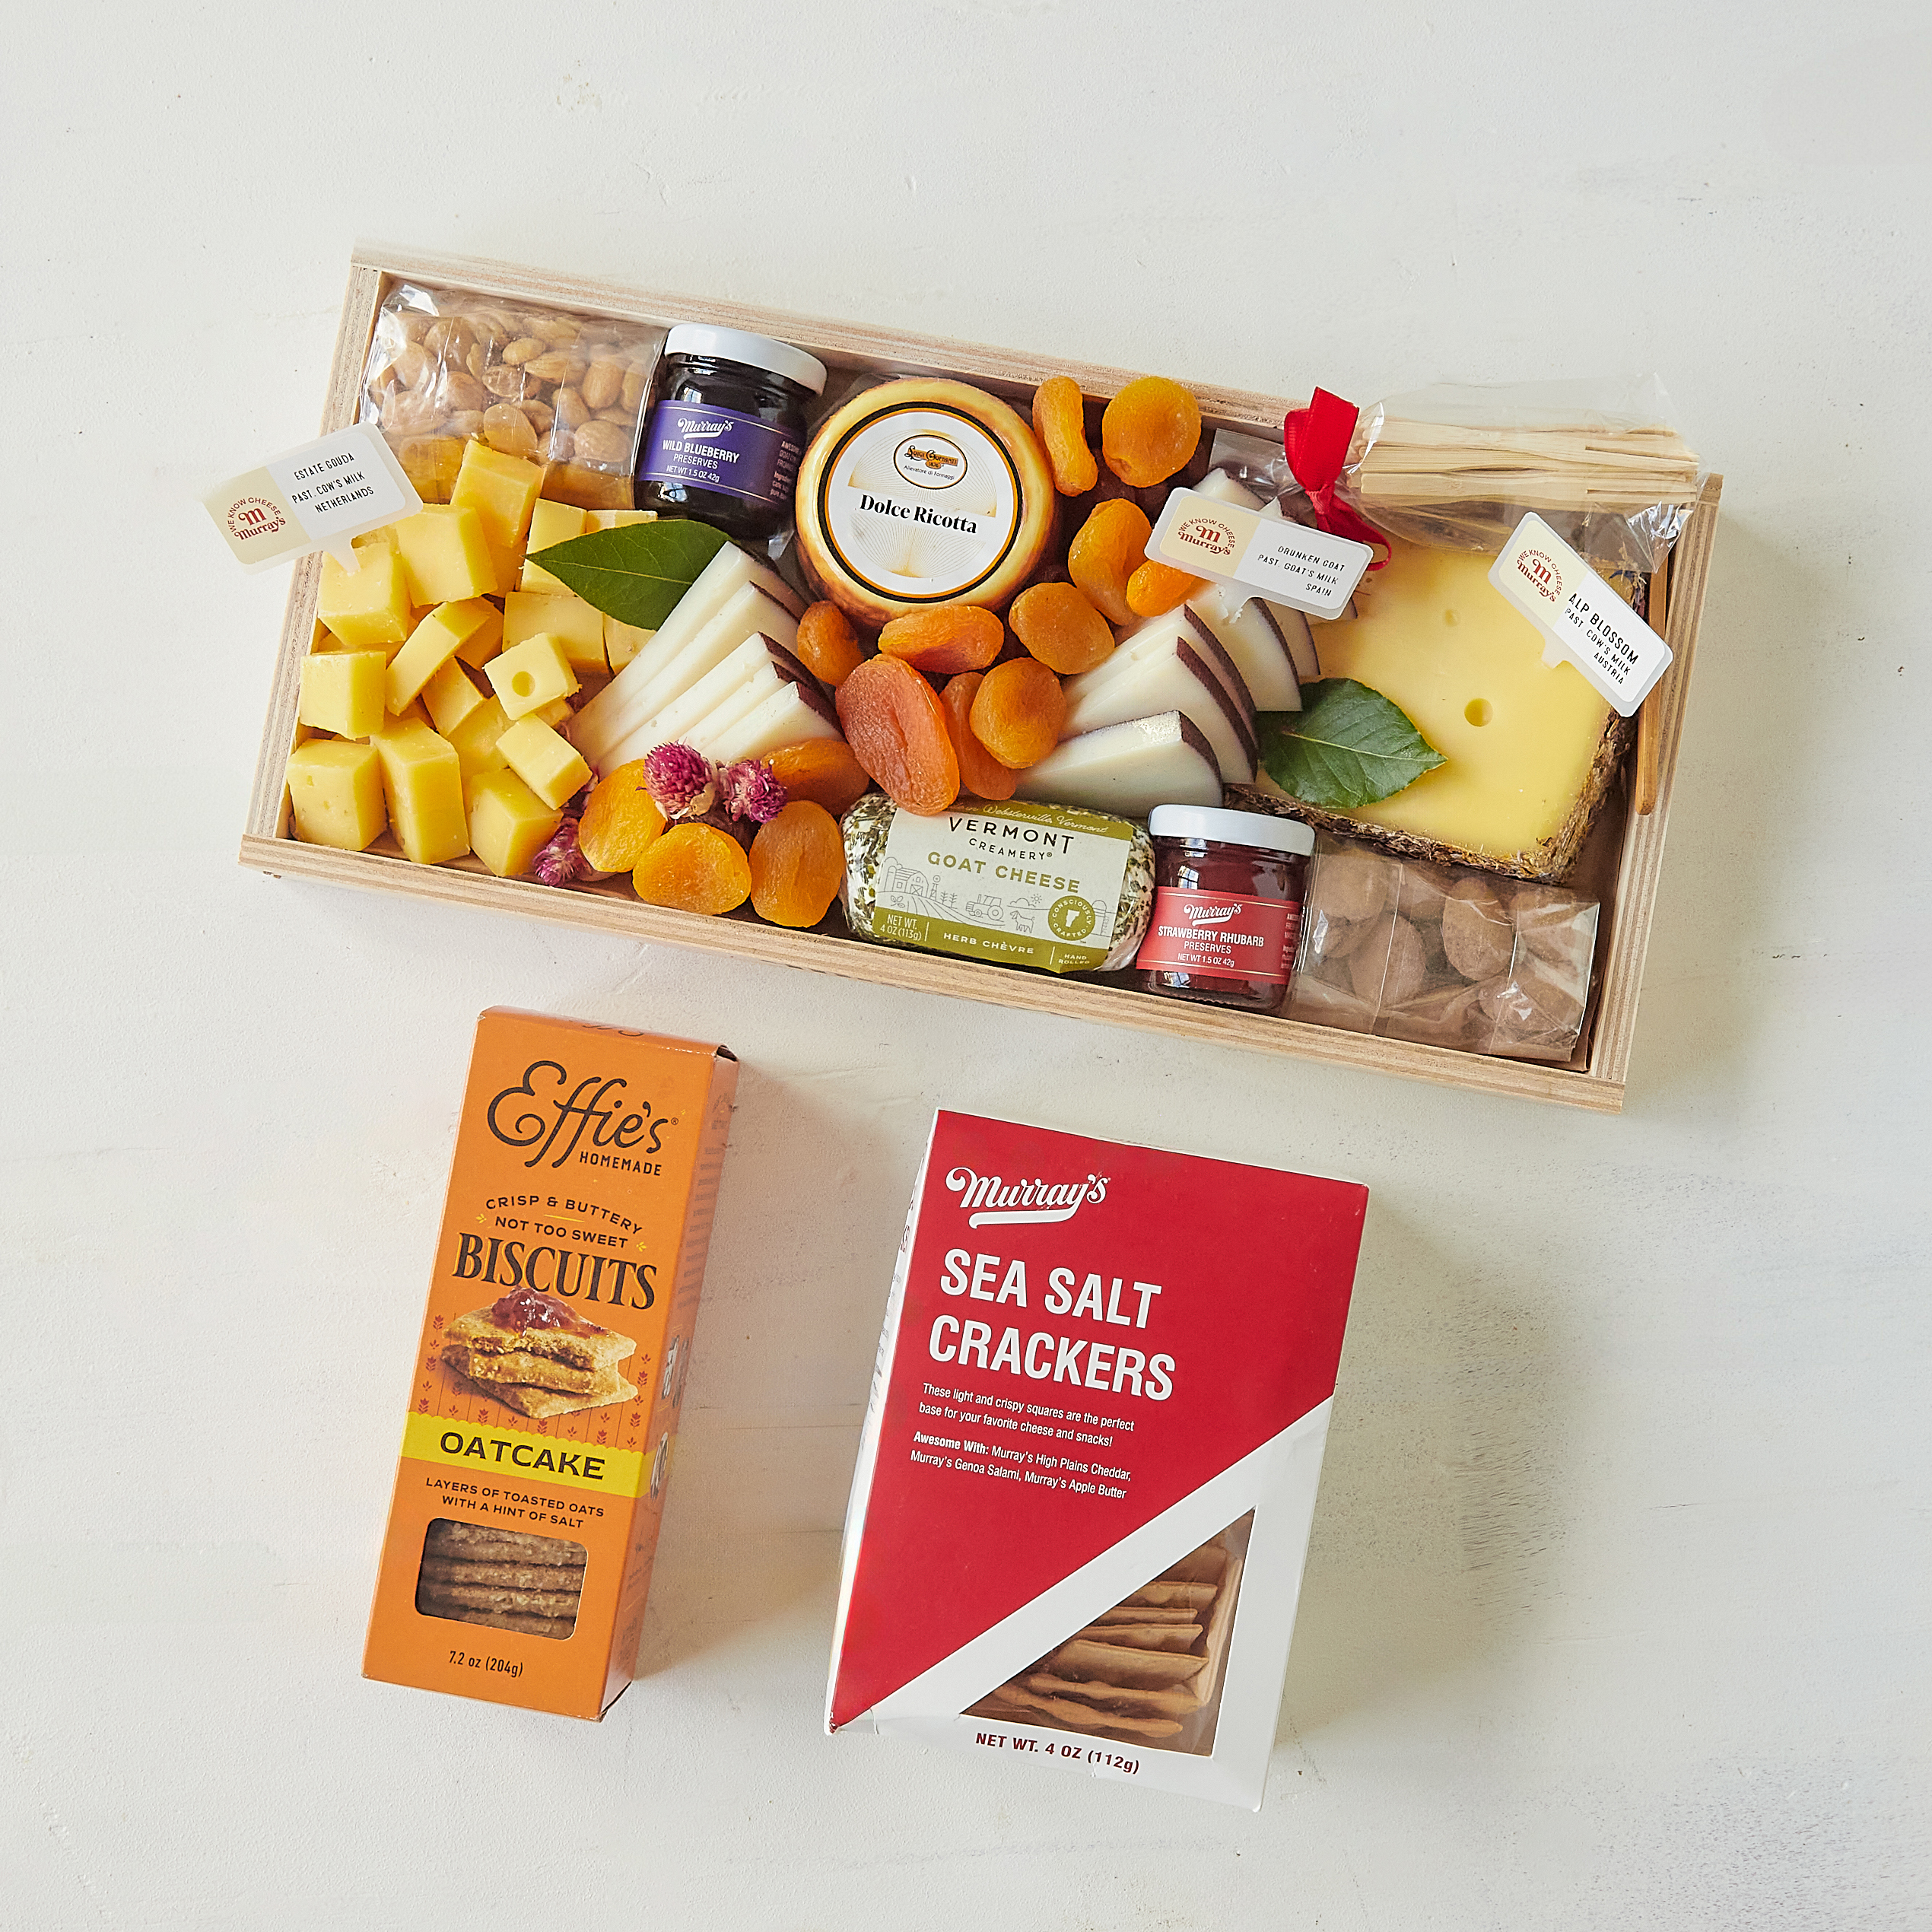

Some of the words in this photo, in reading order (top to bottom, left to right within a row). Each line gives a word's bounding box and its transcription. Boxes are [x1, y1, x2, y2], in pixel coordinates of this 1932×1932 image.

[677, 418, 734, 440] Murray's
[663, 440, 683, 452] WILD
[684, 442, 740, 464] BLUEBERRY
[673, 453, 718, 469] PRESERVES
[294, 463, 324, 481] ESTATE
[326, 453, 354, 471] GOUDA
[666, 465, 677, 473] NET
[678, 466, 688, 475] WT
[688, 468, 697, 477] 1.5
[698, 469, 707, 478] OZ
[707, 471, 720, 483] 42g
[904, 465, 926, 474] Allevatore
[934, 471, 955, 480] Formaggi
[291, 489, 316, 504] PAST.
[316, 479, 342, 496] COW'S
[343, 471, 365, 486] MILK
[314, 486, 374, 513] NETHERLANDS
[227, 498, 246, 518] KNOW
[248, 497, 281, 516] CHEESE
[860, 494, 910, 520] Dolce
[914, 506, 977, 534] Ricotta
[227, 520, 237, 532] WE
[234, 517, 286, 540] Murray's
[1179, 522, 1190, 532] WE
[1218, 523, 1235, 548] CHEESE
[1177, 531, 1231, 555] Murray's
[1257, 554, 1280, 567] PAST.
[1284, 562, 1314, 578] GOAT'S
[1316, 571, 1339, 585] MILK
[1278, 545, 1320, 564] DRUNKEN
[1322, 558, 1345, 572] GOAT
[1518, 551, 1529, 561] WE
[1529, 549, 1552, 563] KNOW
[1551, 563, 1562, 596] CHEESE
[1305, 583, 1332, 597] SPAIN
[1517, 560, 1555, 602] Murray's
[1568, 593, 1590, 614] ALP
[1590, 612, 1639, 666] BLOSSOM
[1586, 629, 1611, 656] COW'S
[1611, 654, 1631, 675] MILK
[1594, 652, 1625, 685] AUSTRIA
[949, 817, 1074, 854] VERMONT
[1057, 815, 1109, 833] Vermont
[928, 851, 987, 874] GOAT
[995, 865, 1080, 894] CHEESE
[887, 914, 903, 926] NET
[904, 917, 917, 930] WT.
[1052, 899, 1092, 925] CONSCIOUSLY
[1184, 903, 1243, 926] Murray's
[880, 923, 885, 933] 4
[887, 925, 898, 936] OZ
[943, 933, 977, 945] HERB
[983, 940, 1034, 954] CHÈVRE
[1053, 923, 1086, 937] CRAFTED
[1158, 925, 1218, 942] STRAWBERRY
[1219, 932, 1264, 947] RHUBARB
[1177, 952, 1190, 961] NET
[1190, 954, 1201, 962] WT
[1203, 955, 1212, 964] 1.5
[1213, 956, 1222, 965] OZ
[1222, 958, 1235, 968] 42g
[1184, 941, 1231, 954] PRESERVES
[579, 1150, 662, 1177] HOMEMADE
[945, 1166, 1111, 1230] Murray's
[485, 1194, 540, 1210] CRISP
[546, 1196, 558, 1208] &
[564, 1200, 643, 1235] BUTTERY
[494, 1215, 529, 1232] NOT
[534, 1222, 567, 1238] TOO
[571, 1230, 629, 1249] SWEET
[451, 1232, 657, 1311] BISCUITS
[939, 1247, 1028, 1308] SEA
[1044, 1266, 1162, 1329] SALT
[928, 1314, 1176, 1402] CRACKERS
[923, 1382, 951, 1399] These
[952, 1388, 974, 1406] light
[975, 1393, 993, 1406] and
[995, 1397, 1025, 1414] crispy
[1026, 1403, 1064, 1419] squares
[1066, 1410, 1082, 1422] are
[1083, 1412, 1098, 1425] the
[1101, 1415, 1135, 1432] perfect
[919, 1402, 942, 1416] base
[943, 1406, 958, 1419] for
[959, 1412, 982, 1425] your
[983, 1413, 1018, 1430] favorite
[1020, 1422, 1054, 1437] cheese
[1056, 1426, 1074, 1441] and
[1076, 1430, 1114, 1447] snacks!
[440, 1432, 605, 1480] OATCAKE
[913, 1431, 961, 1450] Awesome
[963, 1439, 989, 1455] With:
[991, 1445, 1034, 1463] Murray's
[1035, 1453, 1057, 1469] High
[1060, 1458, 1088, 1473] Plains
[1090, 1463, 1132, 1482] Cheddar,
[910, 1450, 953, 1469] Murray's
[955, 1458, 985, 1474] Genoa
[987, 1464, 1022, 1482] Salami,
[1025, 1470, 1066, 1489] Murray's
[1069, 1479, 1096, 1495] Apple
[1098, 1484, 1127, 1500] Butter
[425, 1476, 478, 1495] LAYERS
[481, 1487, 500, 1498] OF
[504, 1491, 565, 1511] TOASTED
[569, 1501, 604, 1517] OATS
[442, 1495, 476, 1510] WITH
[480, 1502, 489, 1512] A
[493, 1504, 526, 1518] HINT
[529, 1511, 547, 1522] OF
[550, 1514, 584, 1529] SALT
[449, 1650, 465, 1666] 7.2
[468, 1657, 481, 1669] oz
[485, 1656, 524, 1678] (204g)
[975, 1732, 1007, 1748] NET
[1012, 1737, 1038, 1752] WT.
[1044, 1743, 1055, 1755] 4
[1060, 1745, 1082, 1759] OZ
[1087, 1750, 1139, 1775] (112g)
